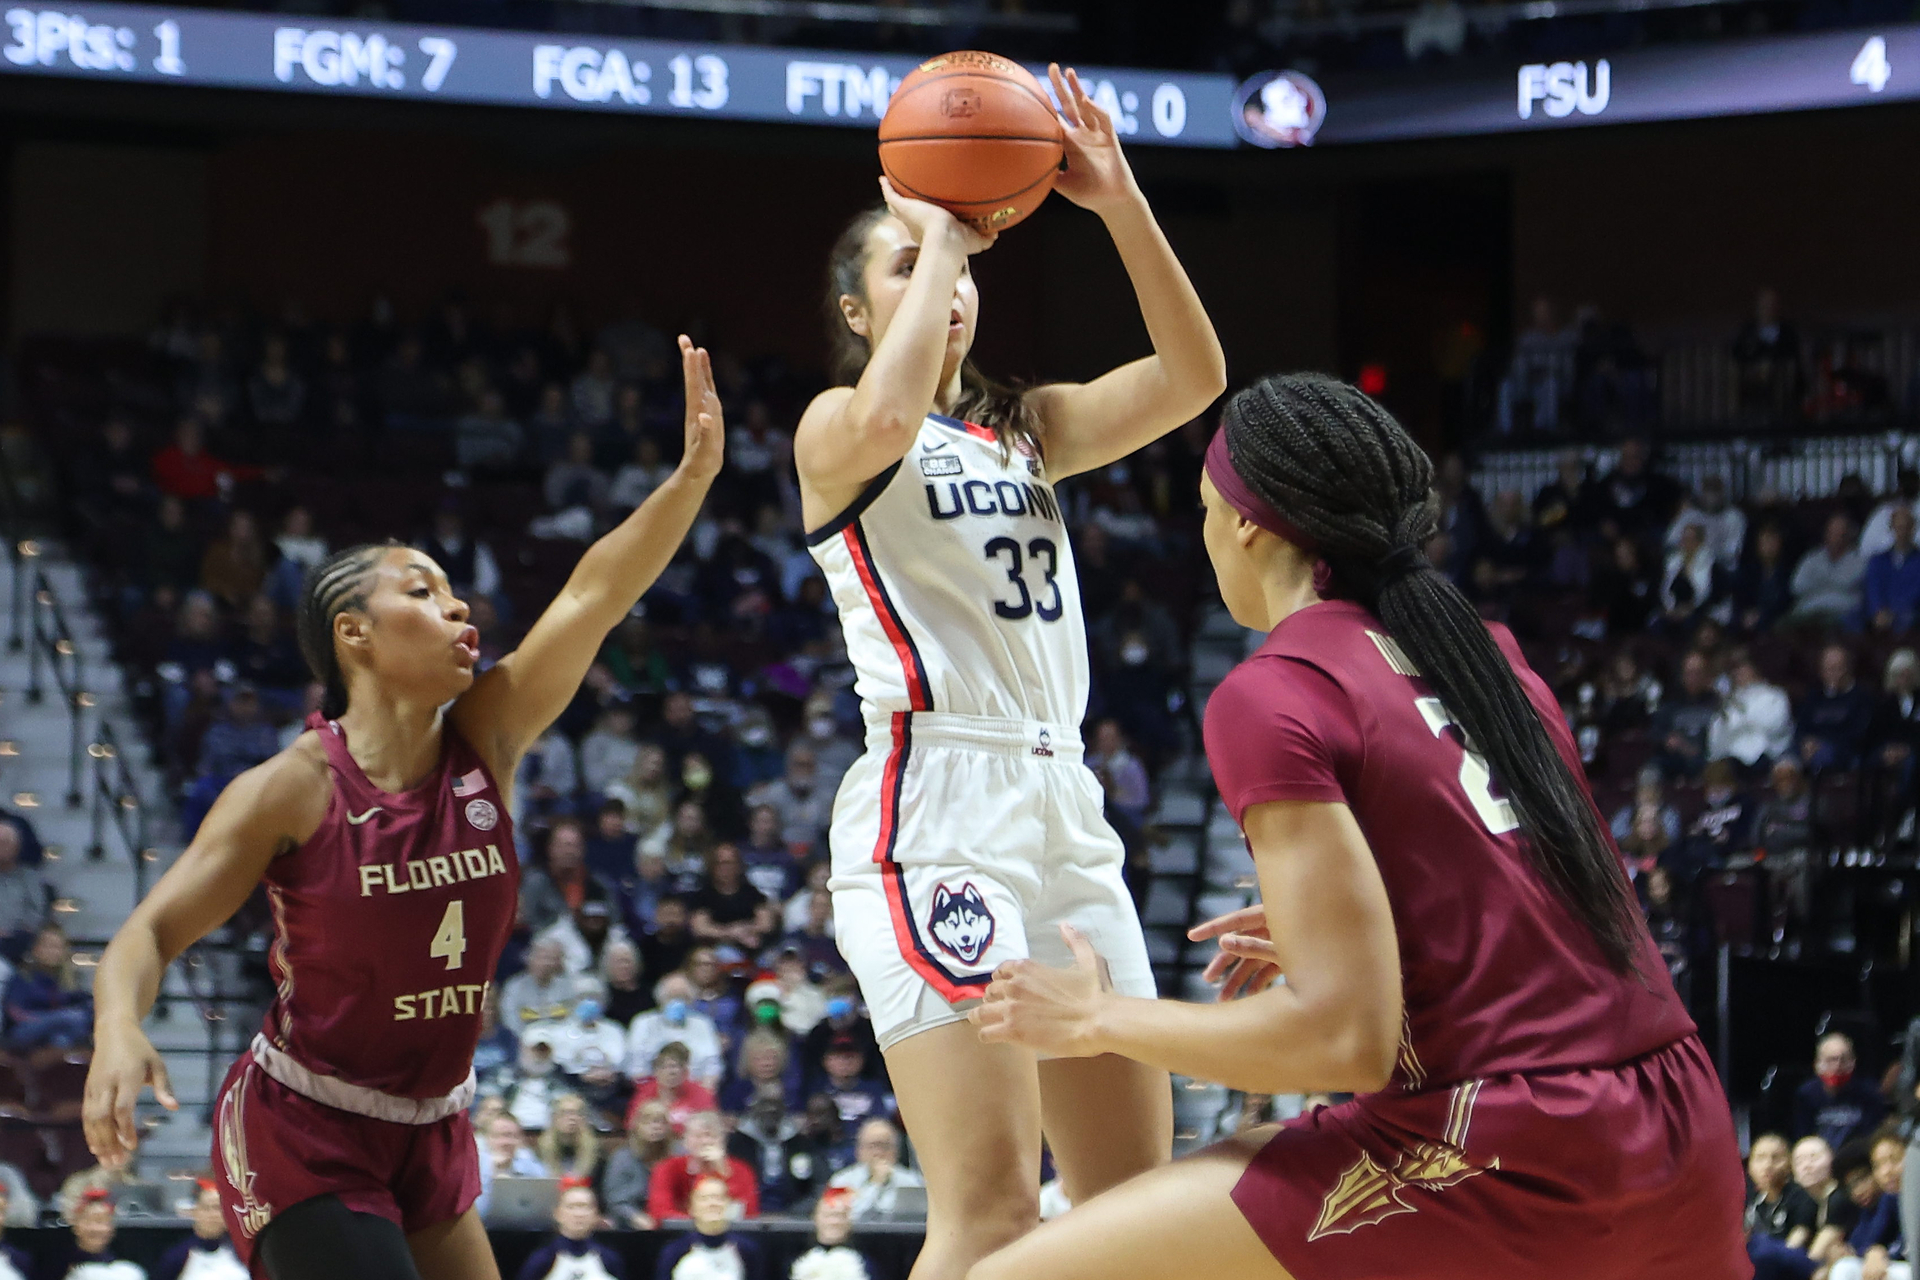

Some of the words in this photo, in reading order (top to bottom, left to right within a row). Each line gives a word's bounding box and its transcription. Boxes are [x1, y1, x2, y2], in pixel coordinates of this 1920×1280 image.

[2, 9, 135, 71] 3Pts:
[154, 20, 185, 76] 1
[273, 28, 405, 90] FGM:
[419, 37, 457, 92] 7
[533, 44, 651, 105] FGA:
[668, 54, 729, 110] 13
[1152, 83, 1187, 138] 0
[1518, 59, 1610, 119] FSU
[1850, 36, 1891, 92] 4
[480, 200, 569, 265] 12
[984, 536, 1063, 622] 33
[358, 845, 507, 896] FLORIDA
[430, 900, 467, 970] 4
